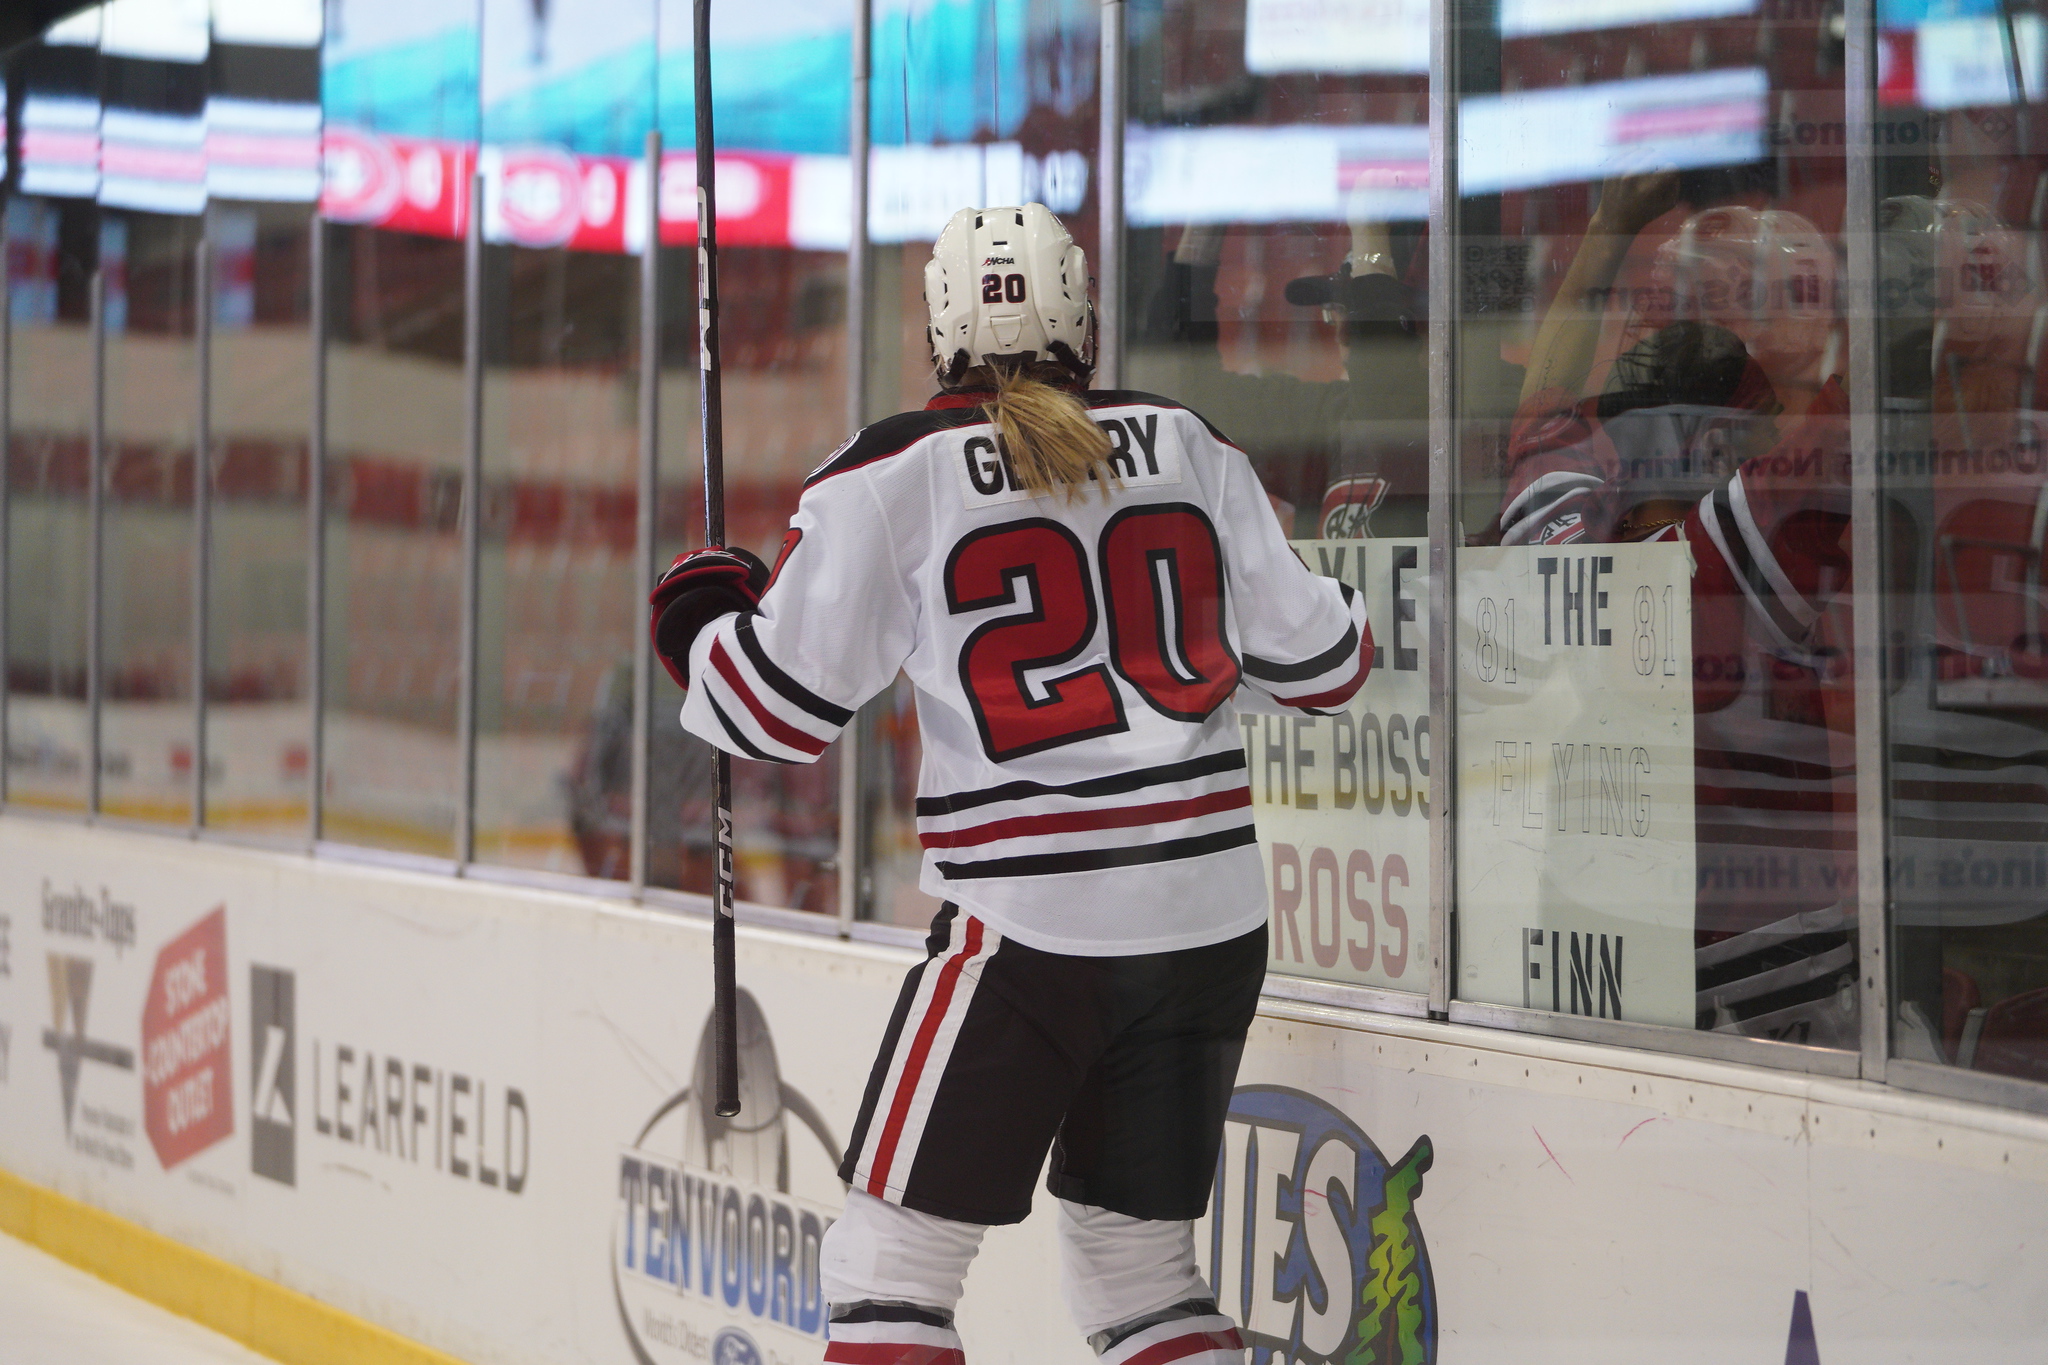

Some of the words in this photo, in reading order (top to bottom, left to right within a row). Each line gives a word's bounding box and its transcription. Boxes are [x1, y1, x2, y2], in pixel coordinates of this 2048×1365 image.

[982, 273, 1026, 304] 20
[963, 414, 1160, 495] GRY
[943, 502, 1242, 764] 20
[1476, 598, 1516, 683] 81
[1537, 556, 1613, 646] THE
[1632, 585, 1675, 675] 81
[1240, 712, 1318, 811] THE
[1333, 710, 1430, 820] BOSS
[1493, 741, 1651, 838] FLYING
[718, 806, 733, 918] CCM
[1272, 842, 1409, 978] ROSS
[1522, 928, 1623, 1020] FINN
[313, 1037, 530, 1195] LEARFIELD
[619, 1154, 831, 1341] TENVOORD
[1192, 1120, 1357, 1357] IES
